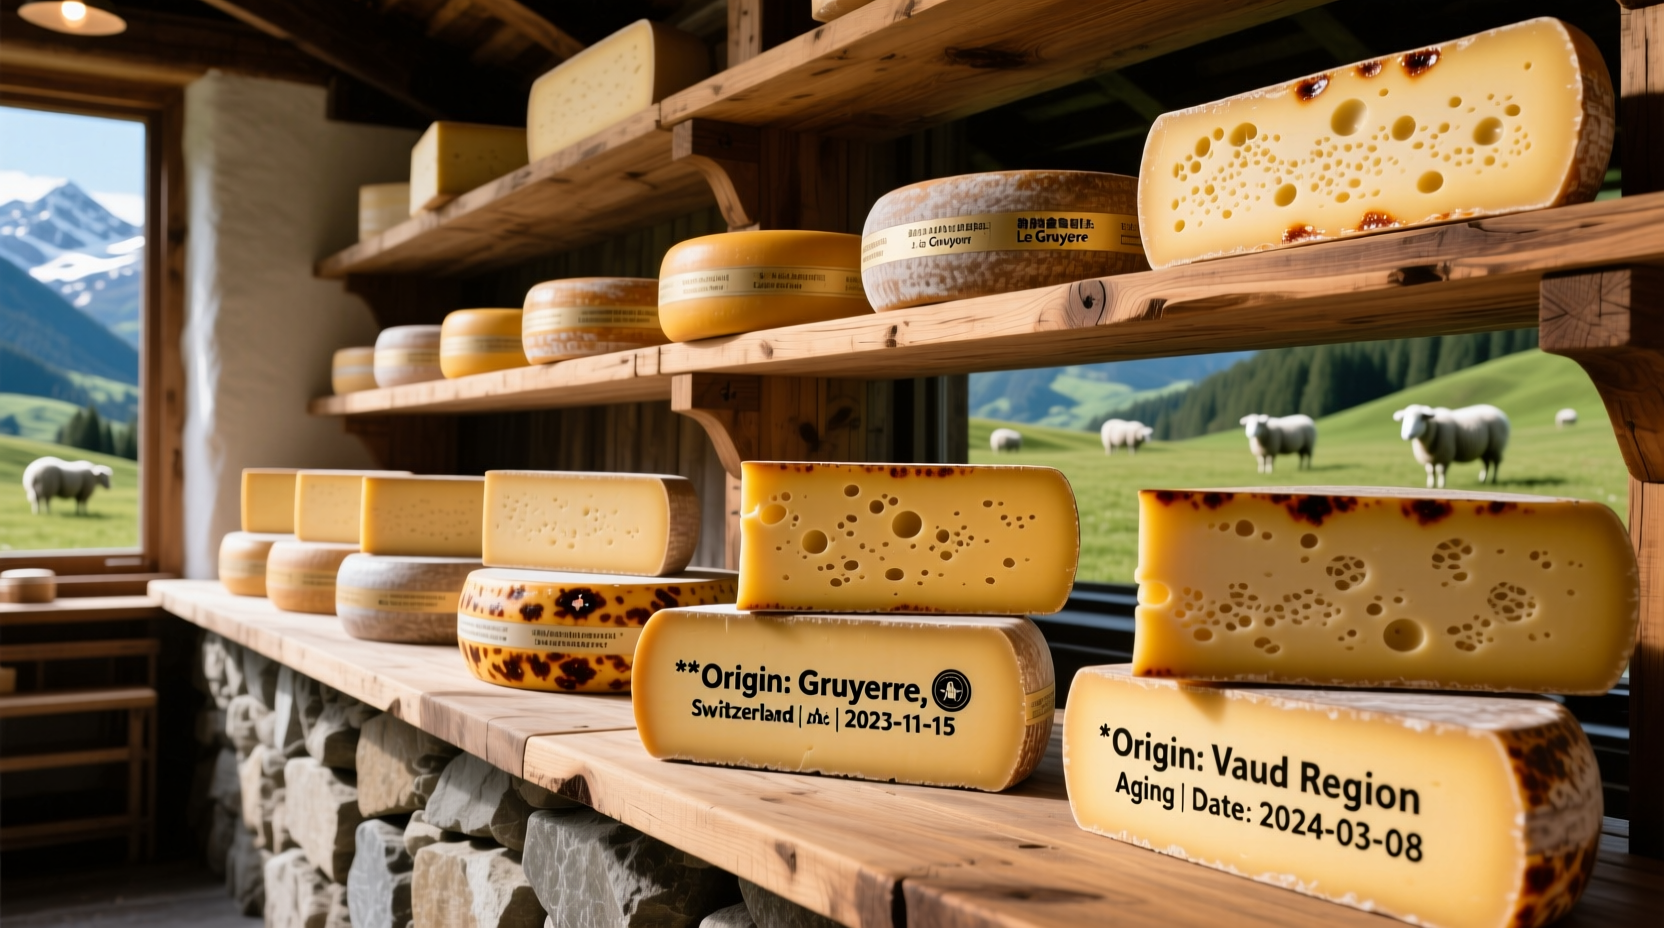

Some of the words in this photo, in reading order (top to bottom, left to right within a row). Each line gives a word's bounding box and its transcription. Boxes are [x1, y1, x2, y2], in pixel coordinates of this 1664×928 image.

[1016, 229, 1033, 243] Le
[1035, 229, 1089, 247] Gruyere
[798, 669, 928, 706] Gruyerre,
[691, 698, 794, 724] Switzerland
[844, 709, 956, 737] 2023-11-15
[1211, 744, 1289, 789] Vaud
[1300, 761, 1421, 815] Region
[1115, 771, 1175, 811] Aging
[1192, 786, 1252, 824] Date:
[1259, 801, 1424, 863] 2024-03-08
